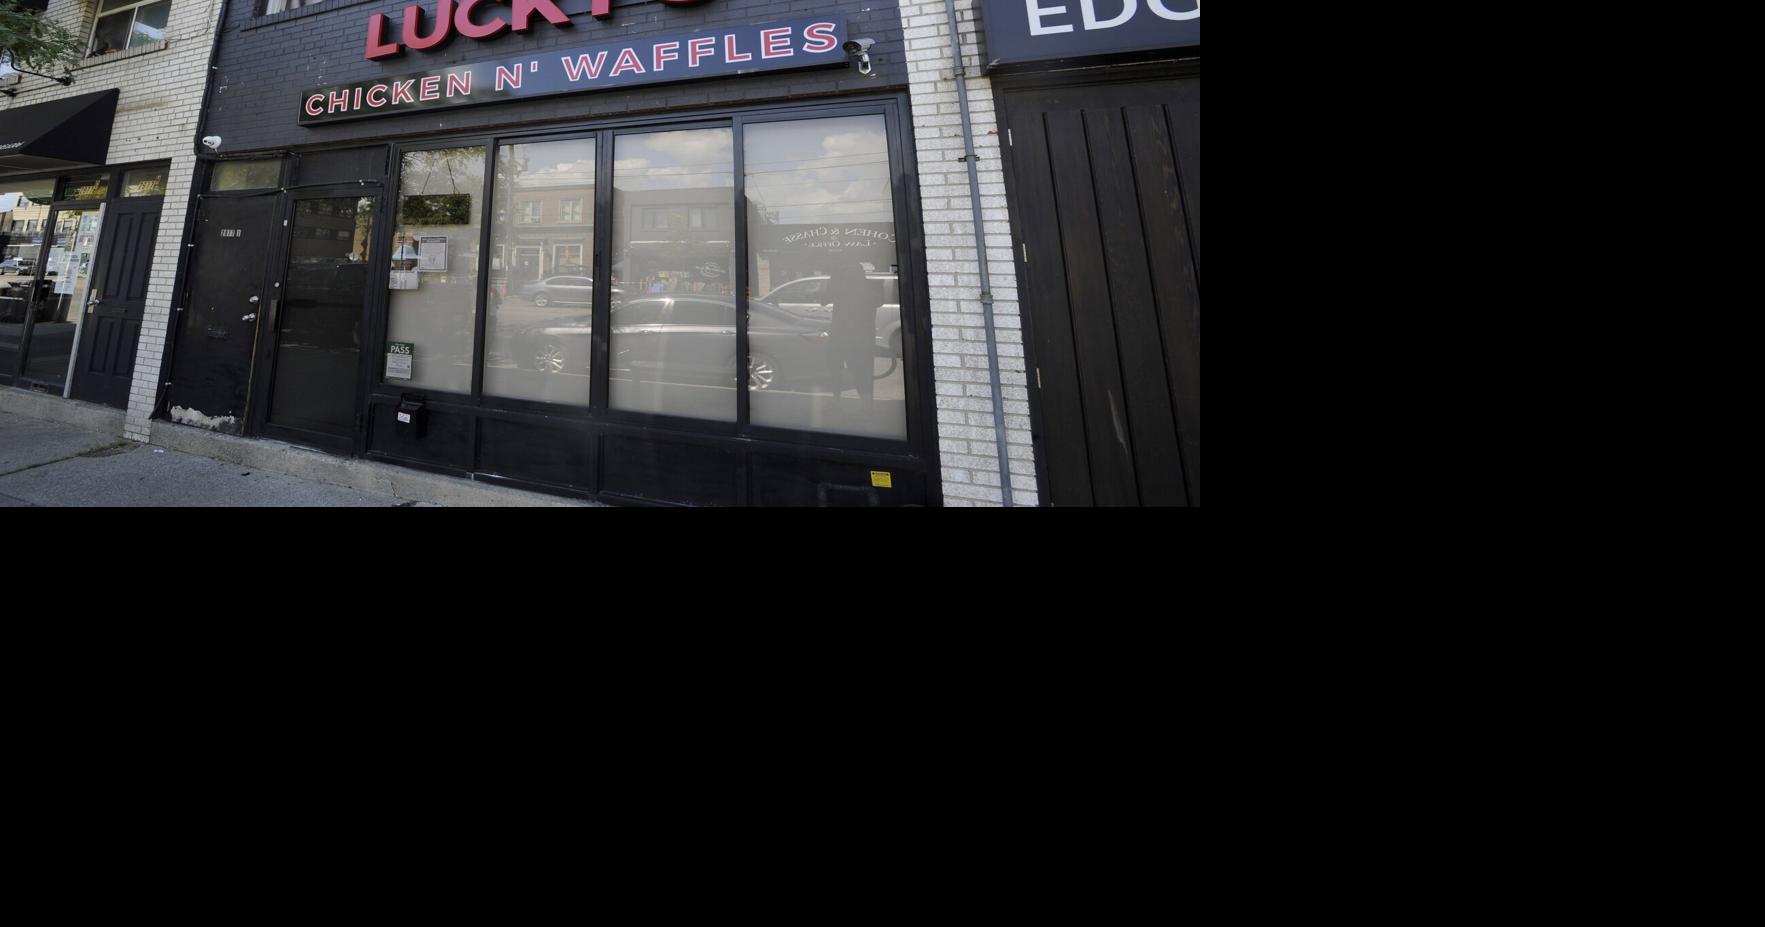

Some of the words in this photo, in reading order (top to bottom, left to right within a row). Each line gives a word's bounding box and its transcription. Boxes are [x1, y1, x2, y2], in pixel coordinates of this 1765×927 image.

[305, 71, 472, 116] CHICKEN
[495, 61, 538, 91] N'
[561, 22, 838, 82] WAFFLES
[390, 345, 410, 355] PASS
